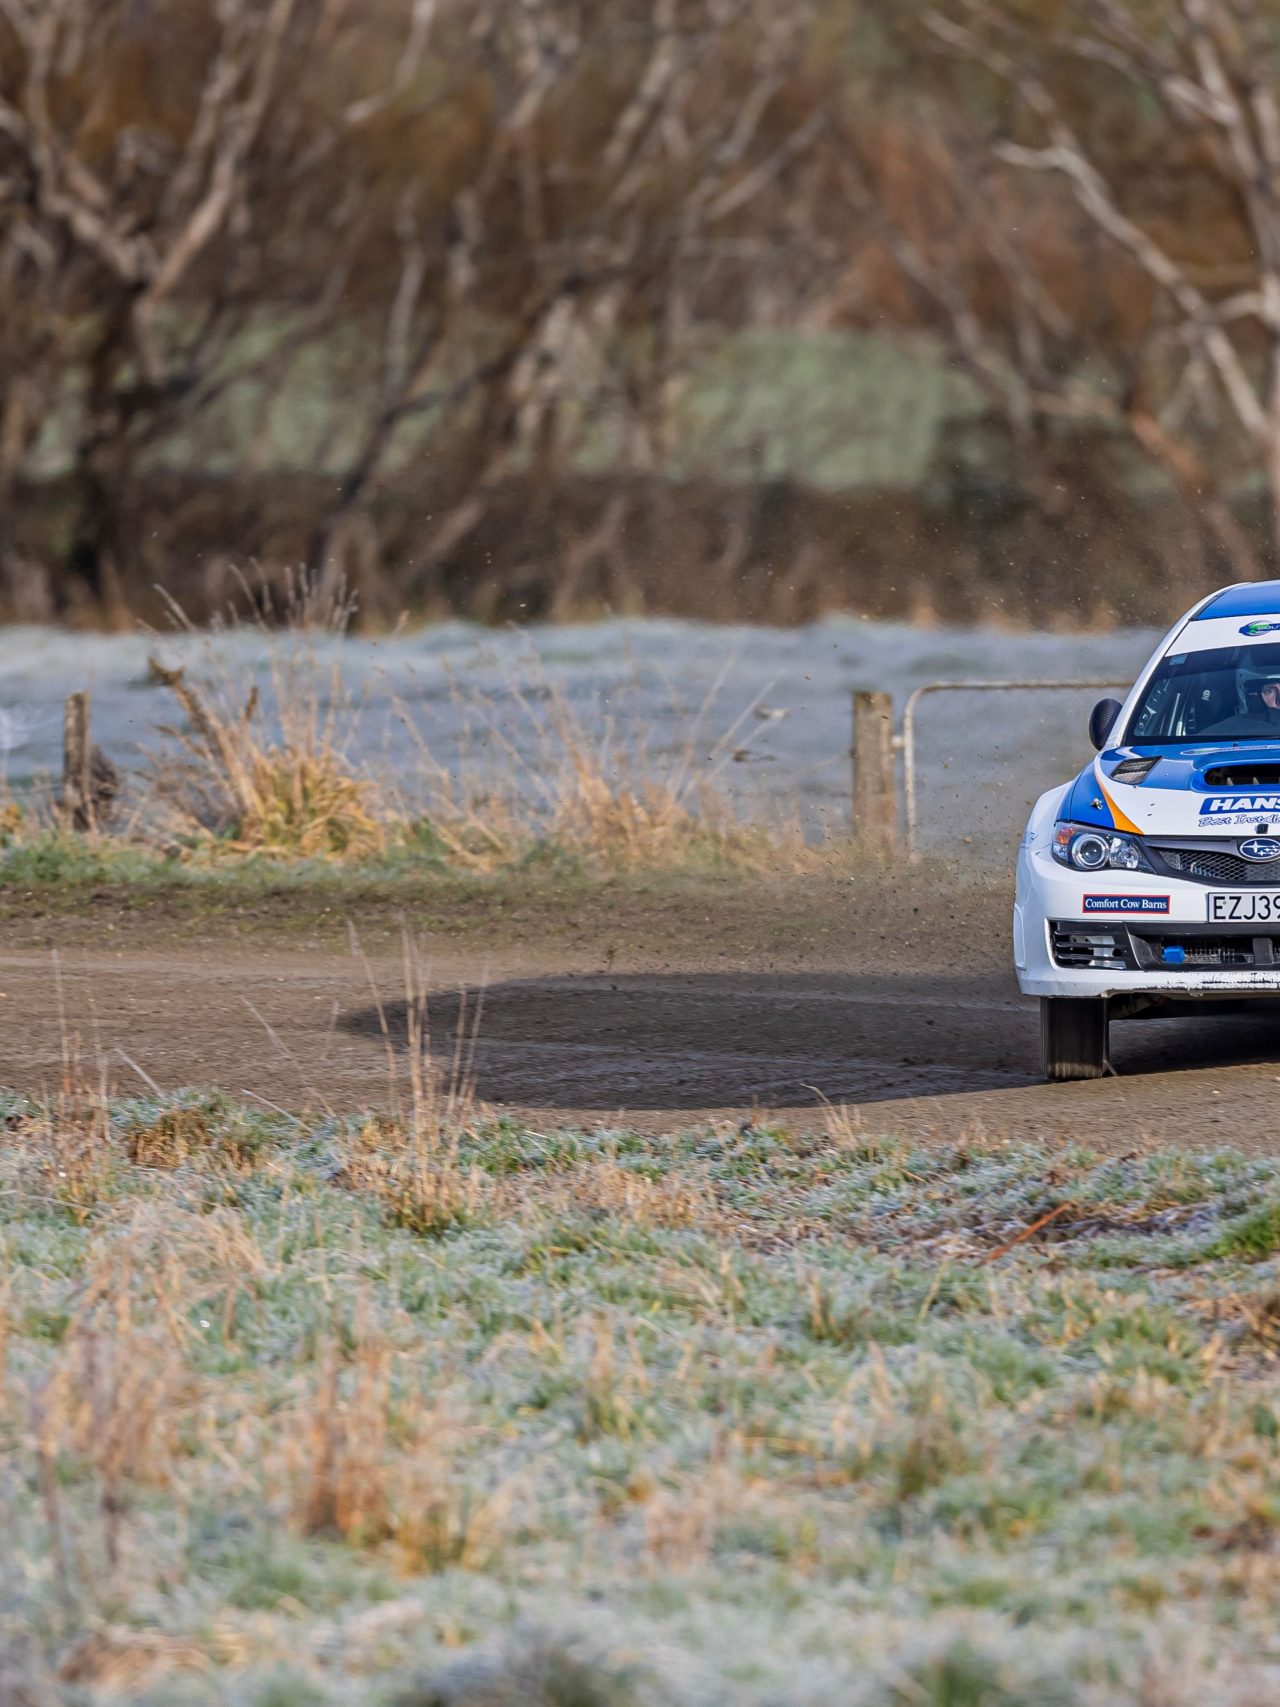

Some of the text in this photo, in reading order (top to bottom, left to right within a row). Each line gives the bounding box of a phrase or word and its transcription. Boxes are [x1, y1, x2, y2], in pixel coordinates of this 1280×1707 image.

[1198, 816, 1231, 827] Best
[1085, 898, 1168, 909] Comfort Cow Barns
